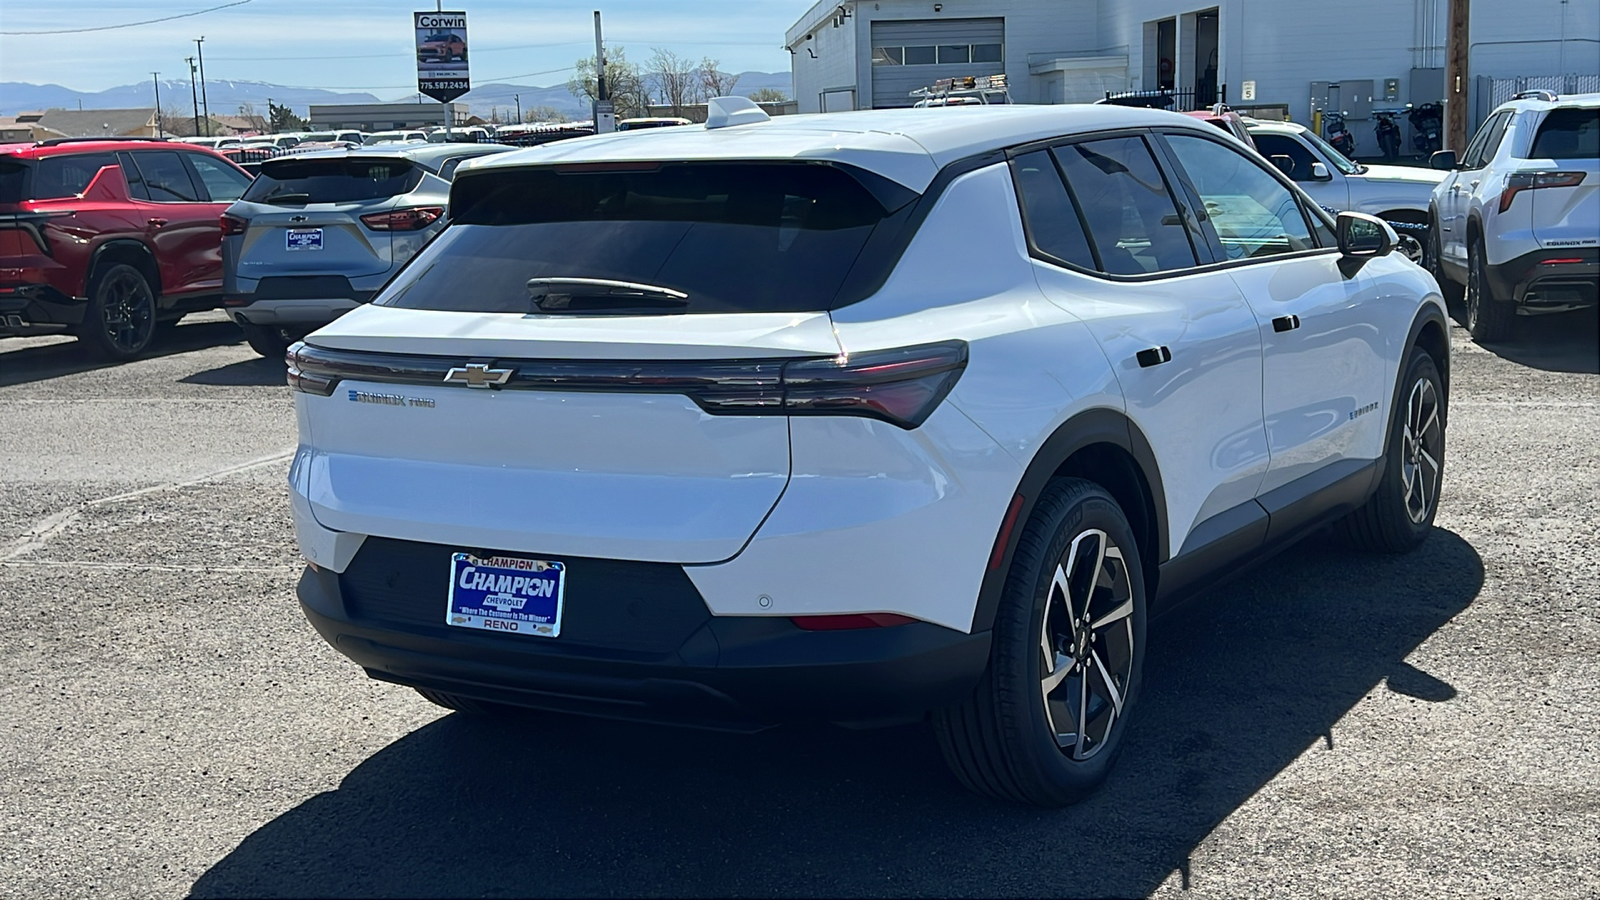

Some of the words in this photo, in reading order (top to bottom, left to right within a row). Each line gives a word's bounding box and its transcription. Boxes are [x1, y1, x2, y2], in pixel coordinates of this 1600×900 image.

[420, 15, 465, 27] Corwin
[420, 81, 468, 90] 775.587.2434
[1245, 90, 1252, 98] 5
[481, 558, 533, 570] CHAMPION
[459, 566, 555, 598] CHAMPION
[486, 596, 524, 607] CHEVROLET
[484, 620, 519, 631] RENO
